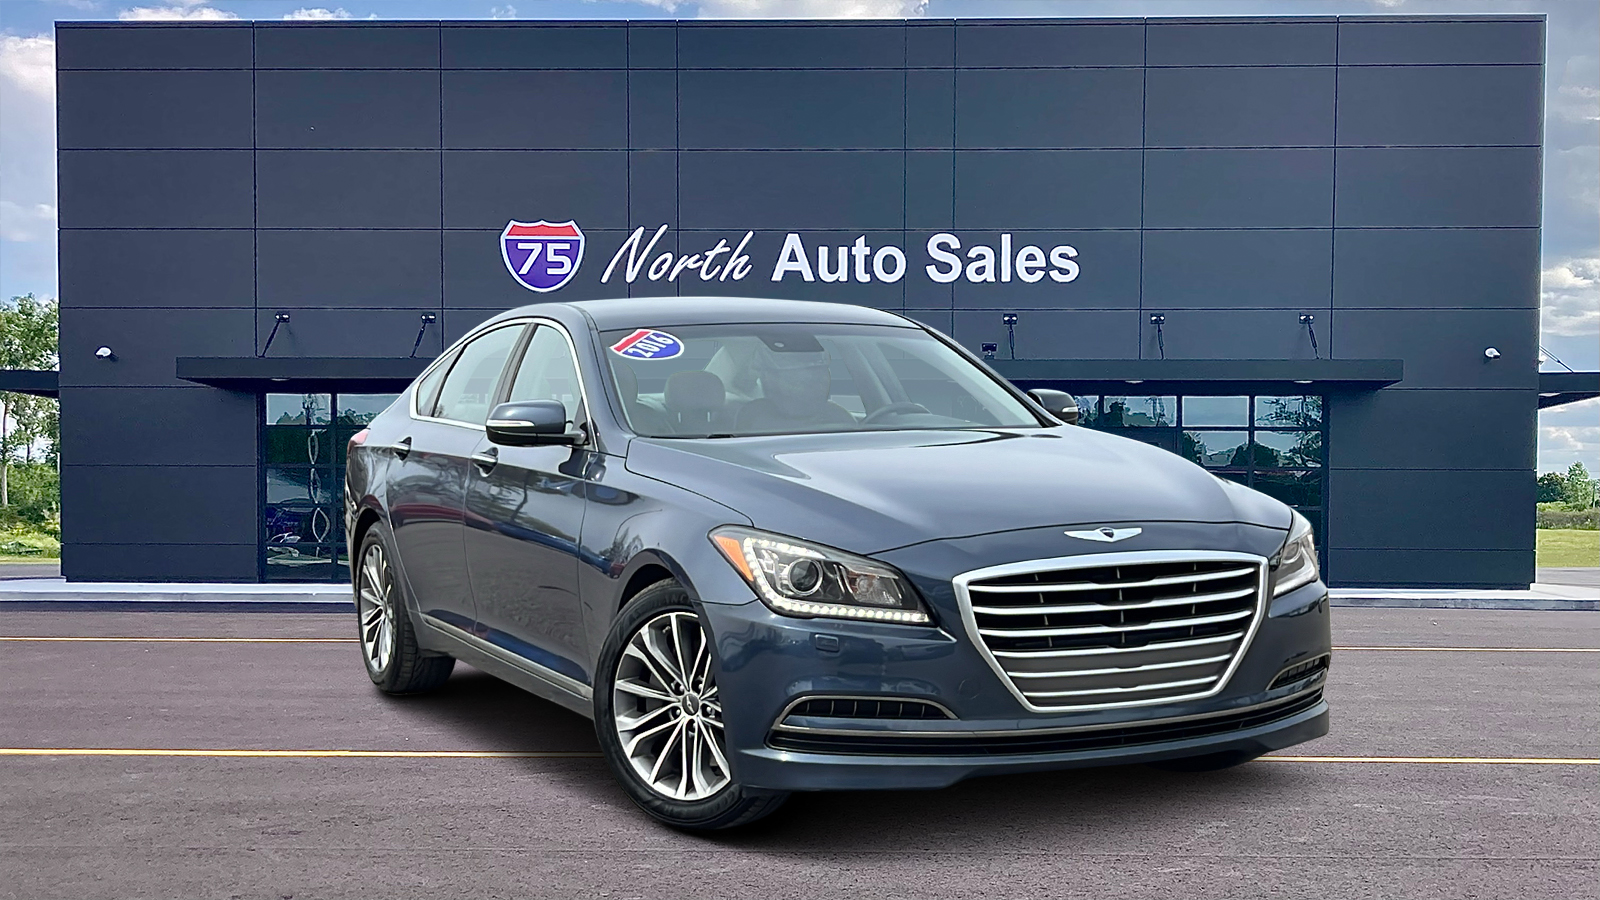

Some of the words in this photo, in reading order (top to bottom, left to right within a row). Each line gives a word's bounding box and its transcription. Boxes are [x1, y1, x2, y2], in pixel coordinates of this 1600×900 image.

[517, 242, 572, 275] 75
[600, 224, 754, 284] North
[771, 233, 906, 283] Auto
[925, 232, 1080, 284] Sales
[627, 334, 675, 358] 2016
